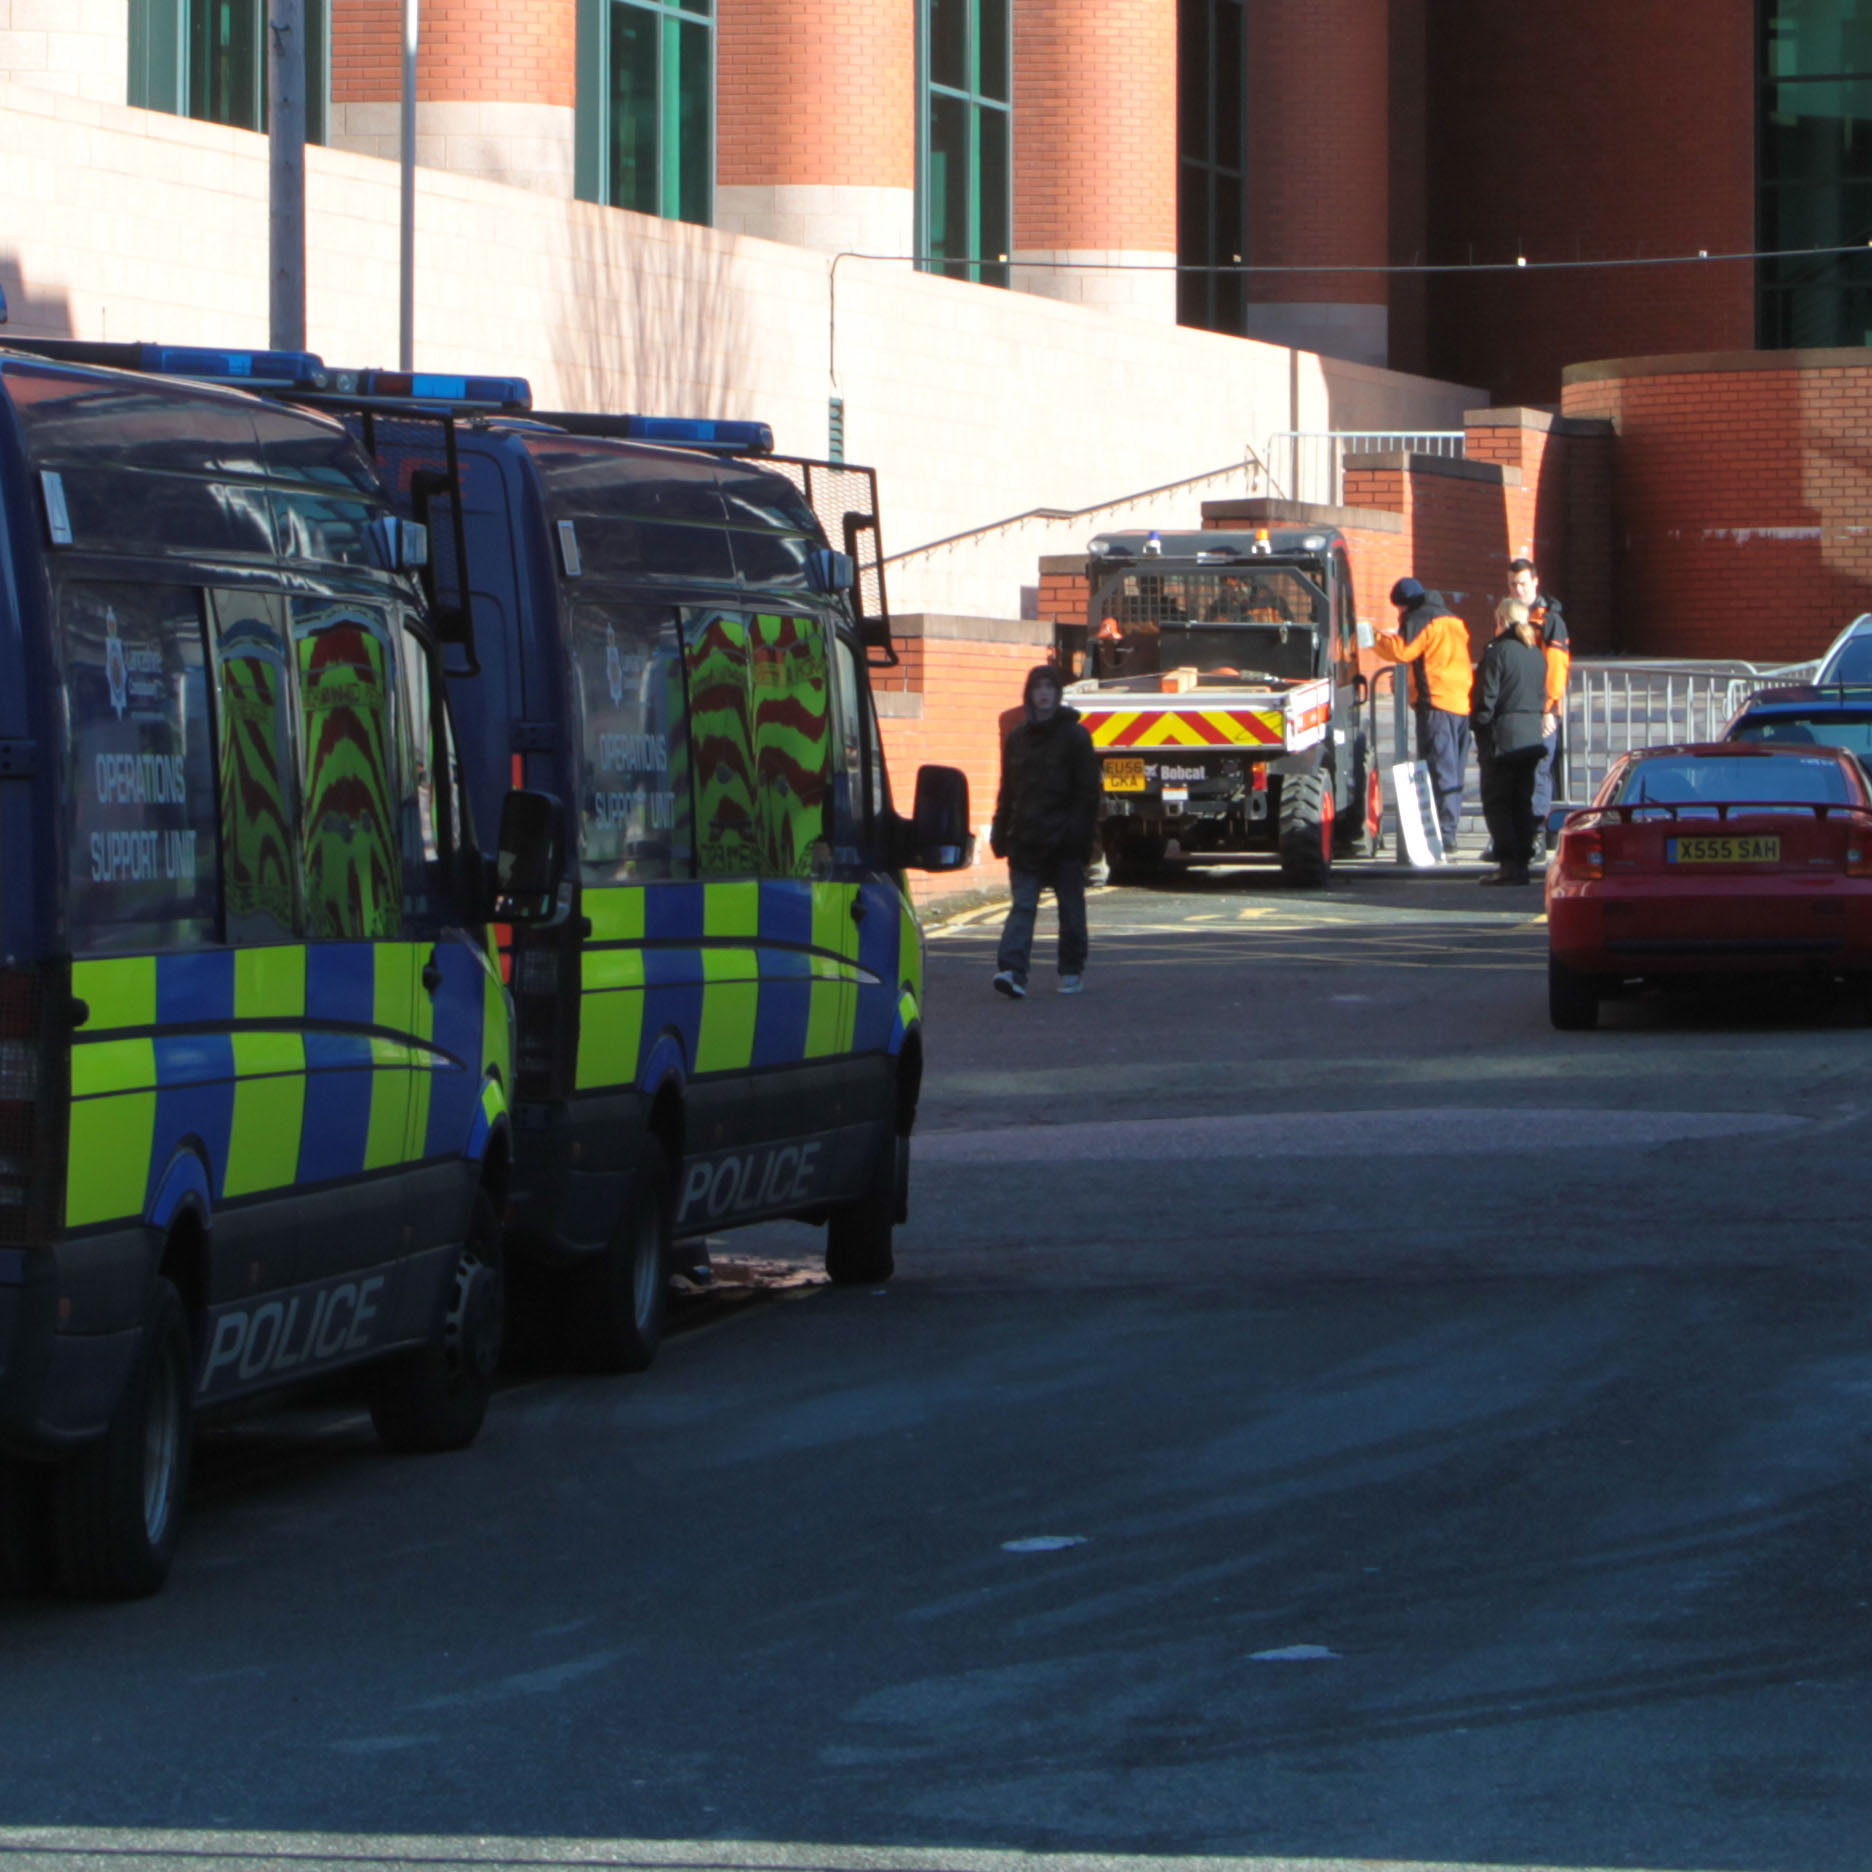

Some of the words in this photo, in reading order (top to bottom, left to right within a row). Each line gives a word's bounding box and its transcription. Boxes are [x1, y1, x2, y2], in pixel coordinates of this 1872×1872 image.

[599, 733, 668, 772] OPERATIONS
[1160, 765, 1205, 780] Bobcat
[95, 753, 186, 804] OPERATIONS
[651, 792, 676, 829] UNIT
[90, 831, 159, 883] SUPPORT
[164, 830, 197, 879] UNIT
[1681, 840, 1733, 860] X555
[1738, 838, 1777, 859] SAH
[677, 1141, 823, 1223] POLICE
[197, 1275, 385, 1393] POLICE
